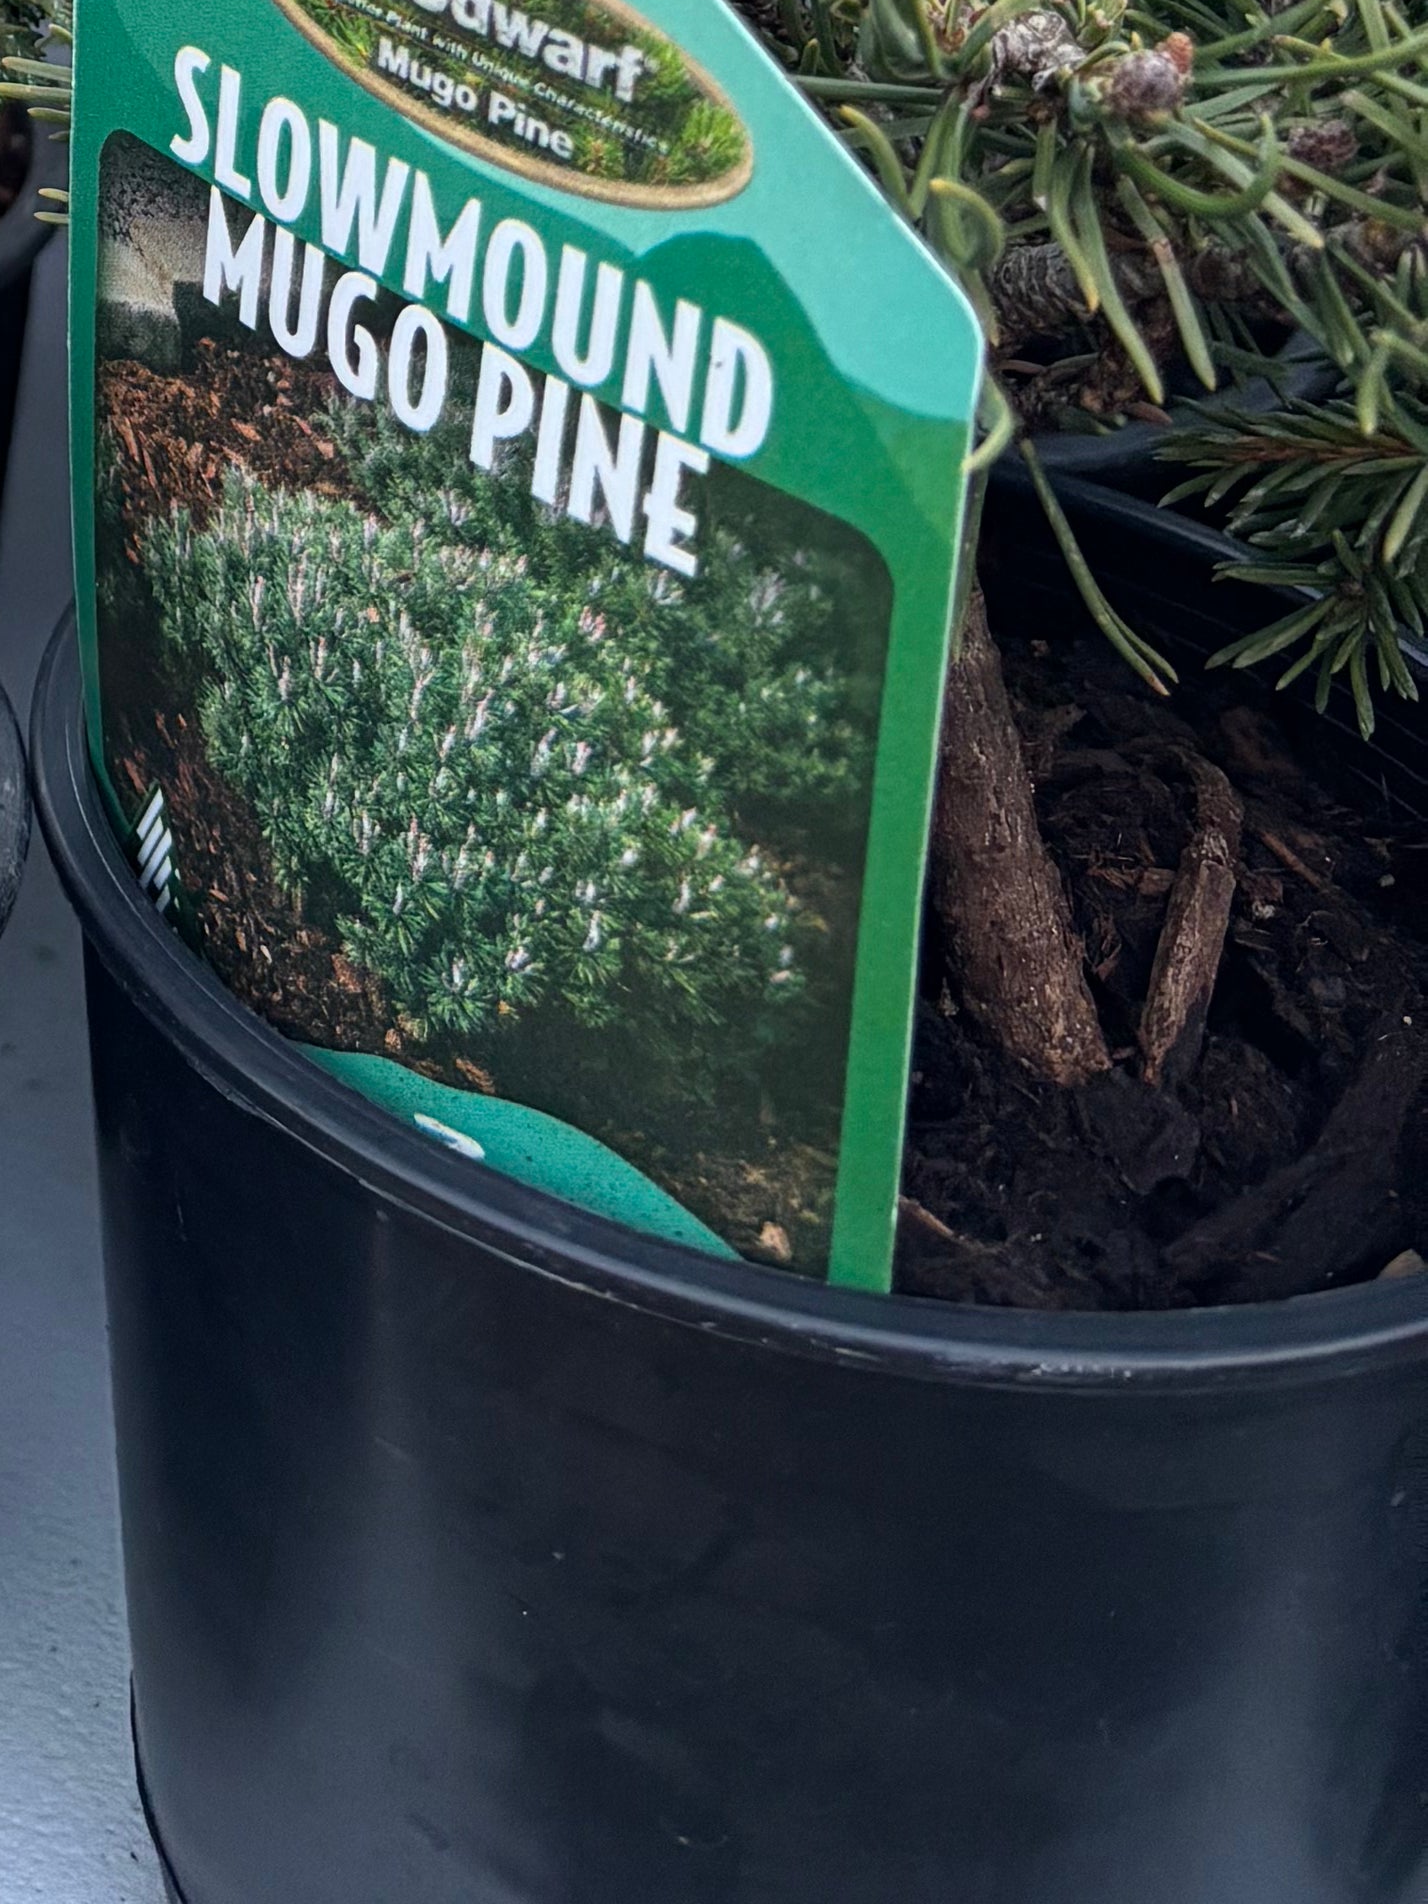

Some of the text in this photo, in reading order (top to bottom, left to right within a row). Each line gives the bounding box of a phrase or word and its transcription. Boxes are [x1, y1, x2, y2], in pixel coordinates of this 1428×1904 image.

[169, 45, 774, 460] SLOWMOUND
[378, 35, 575, 160] Mugo Pine
[202, 184, 710, 578] MUGO PINE
